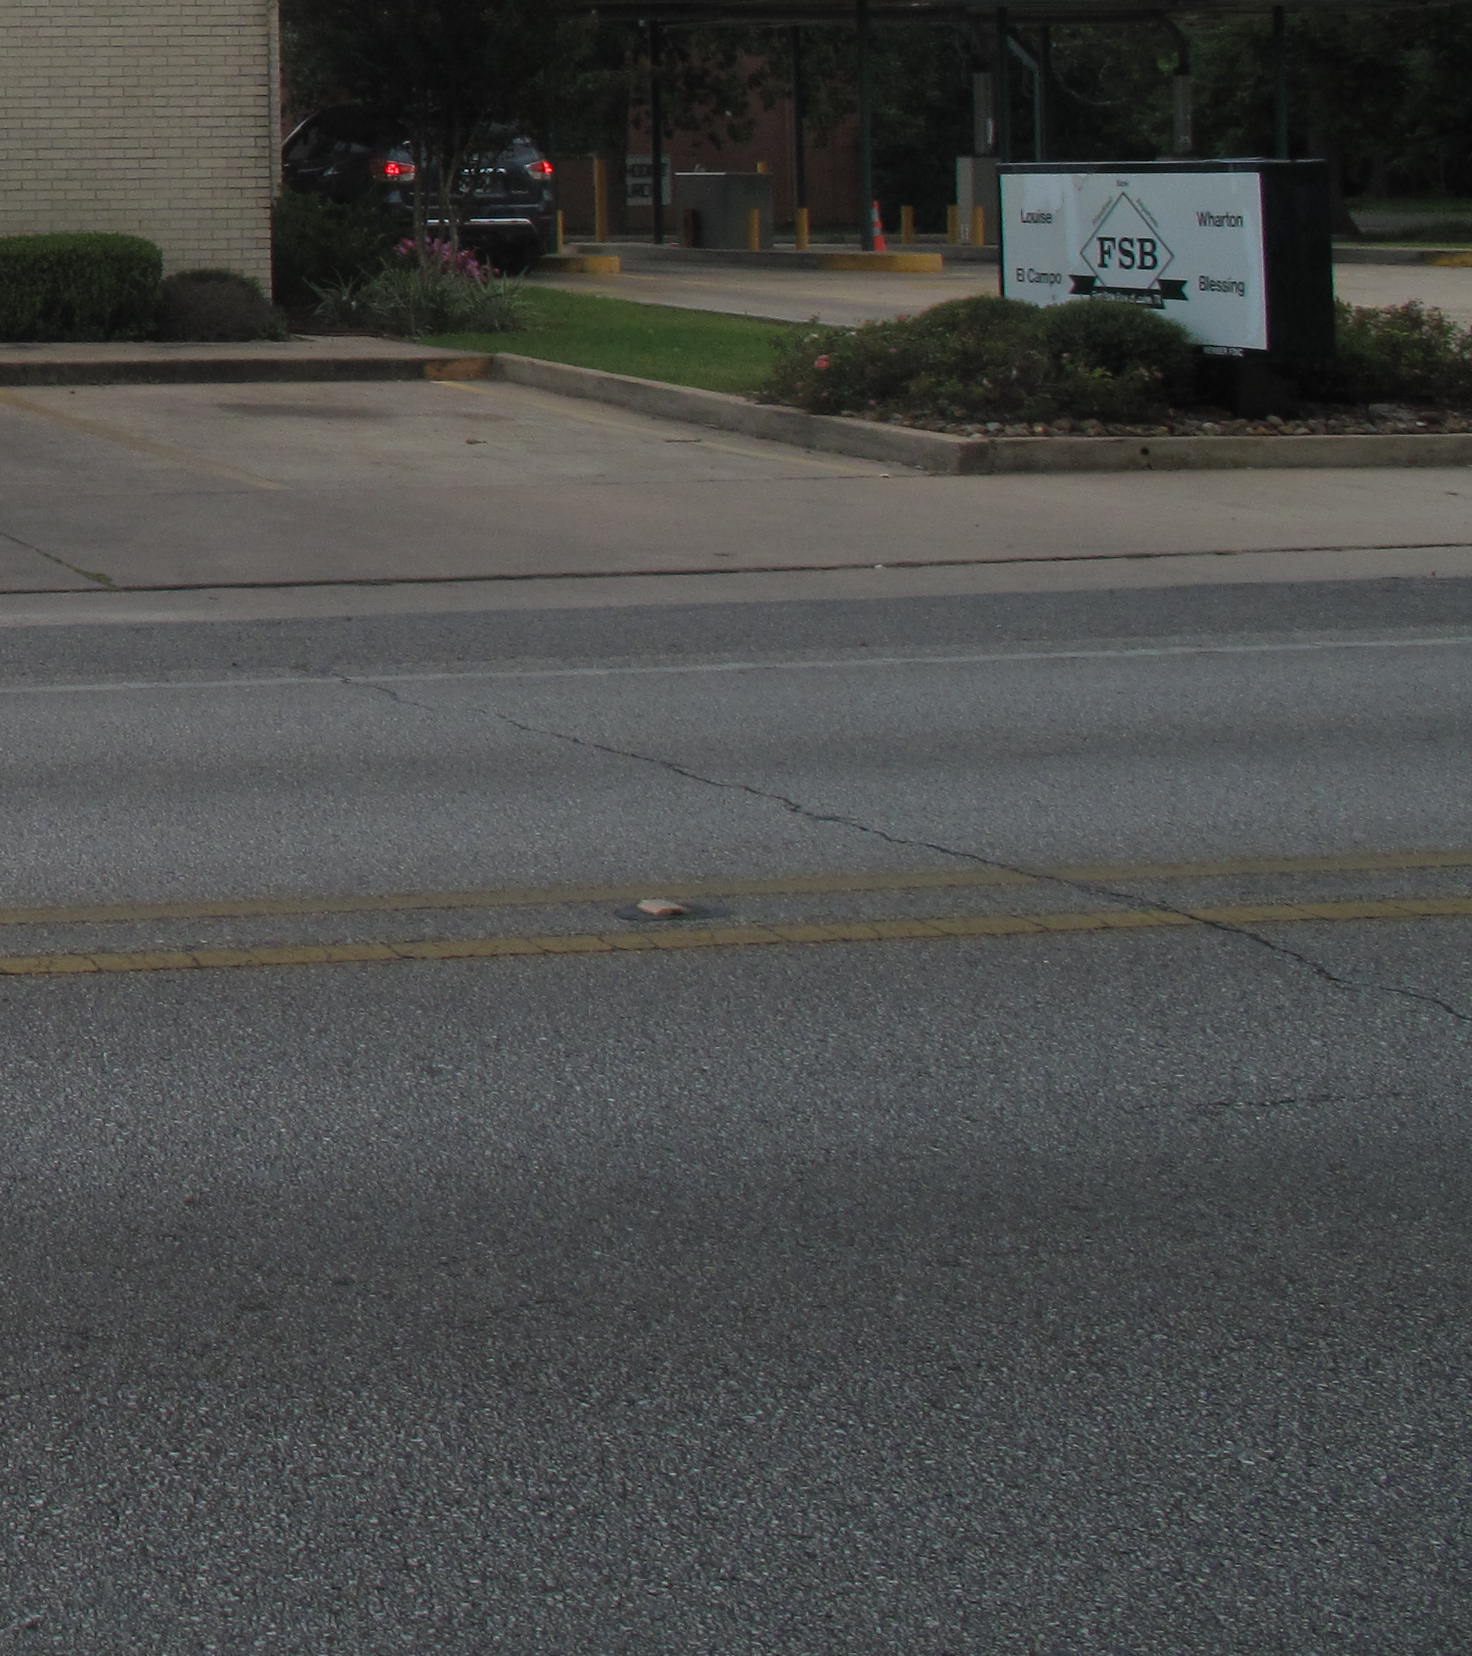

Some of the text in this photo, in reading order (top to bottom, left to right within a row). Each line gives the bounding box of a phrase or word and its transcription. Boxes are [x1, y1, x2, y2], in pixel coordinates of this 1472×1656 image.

[1019, 209, 1053, 225] Louise
[1196, 210, 1244, 229] Wharton
[1097, 237, 1158, 270] FSB
[1016, 268, 1062, 286] El Campo
[1199, 275, 1246, 297] Blessing
